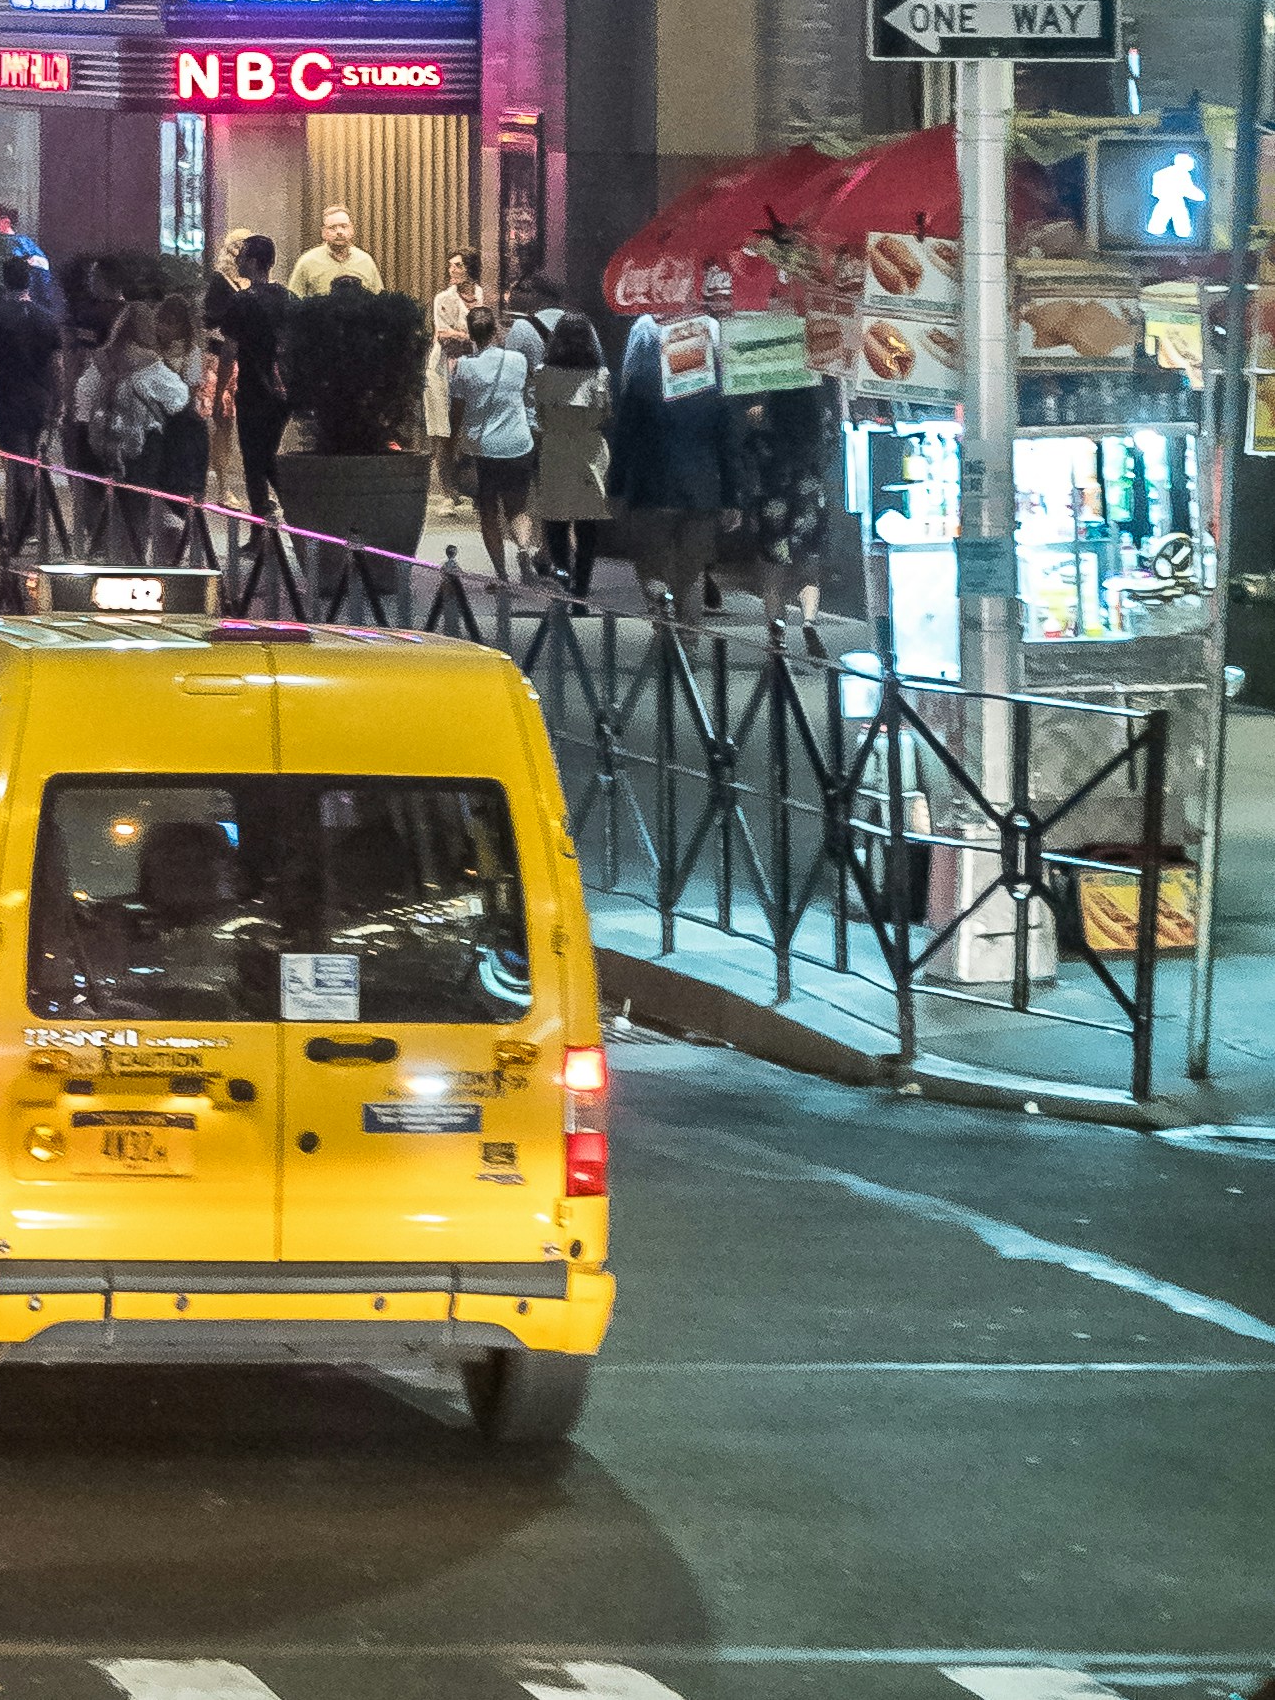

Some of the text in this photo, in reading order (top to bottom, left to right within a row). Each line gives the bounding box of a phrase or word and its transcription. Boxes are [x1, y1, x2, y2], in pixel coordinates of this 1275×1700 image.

[909, 2, 1086, 35] ONE WAY
[177, 51, 441, 101] NBC STUDIOS
